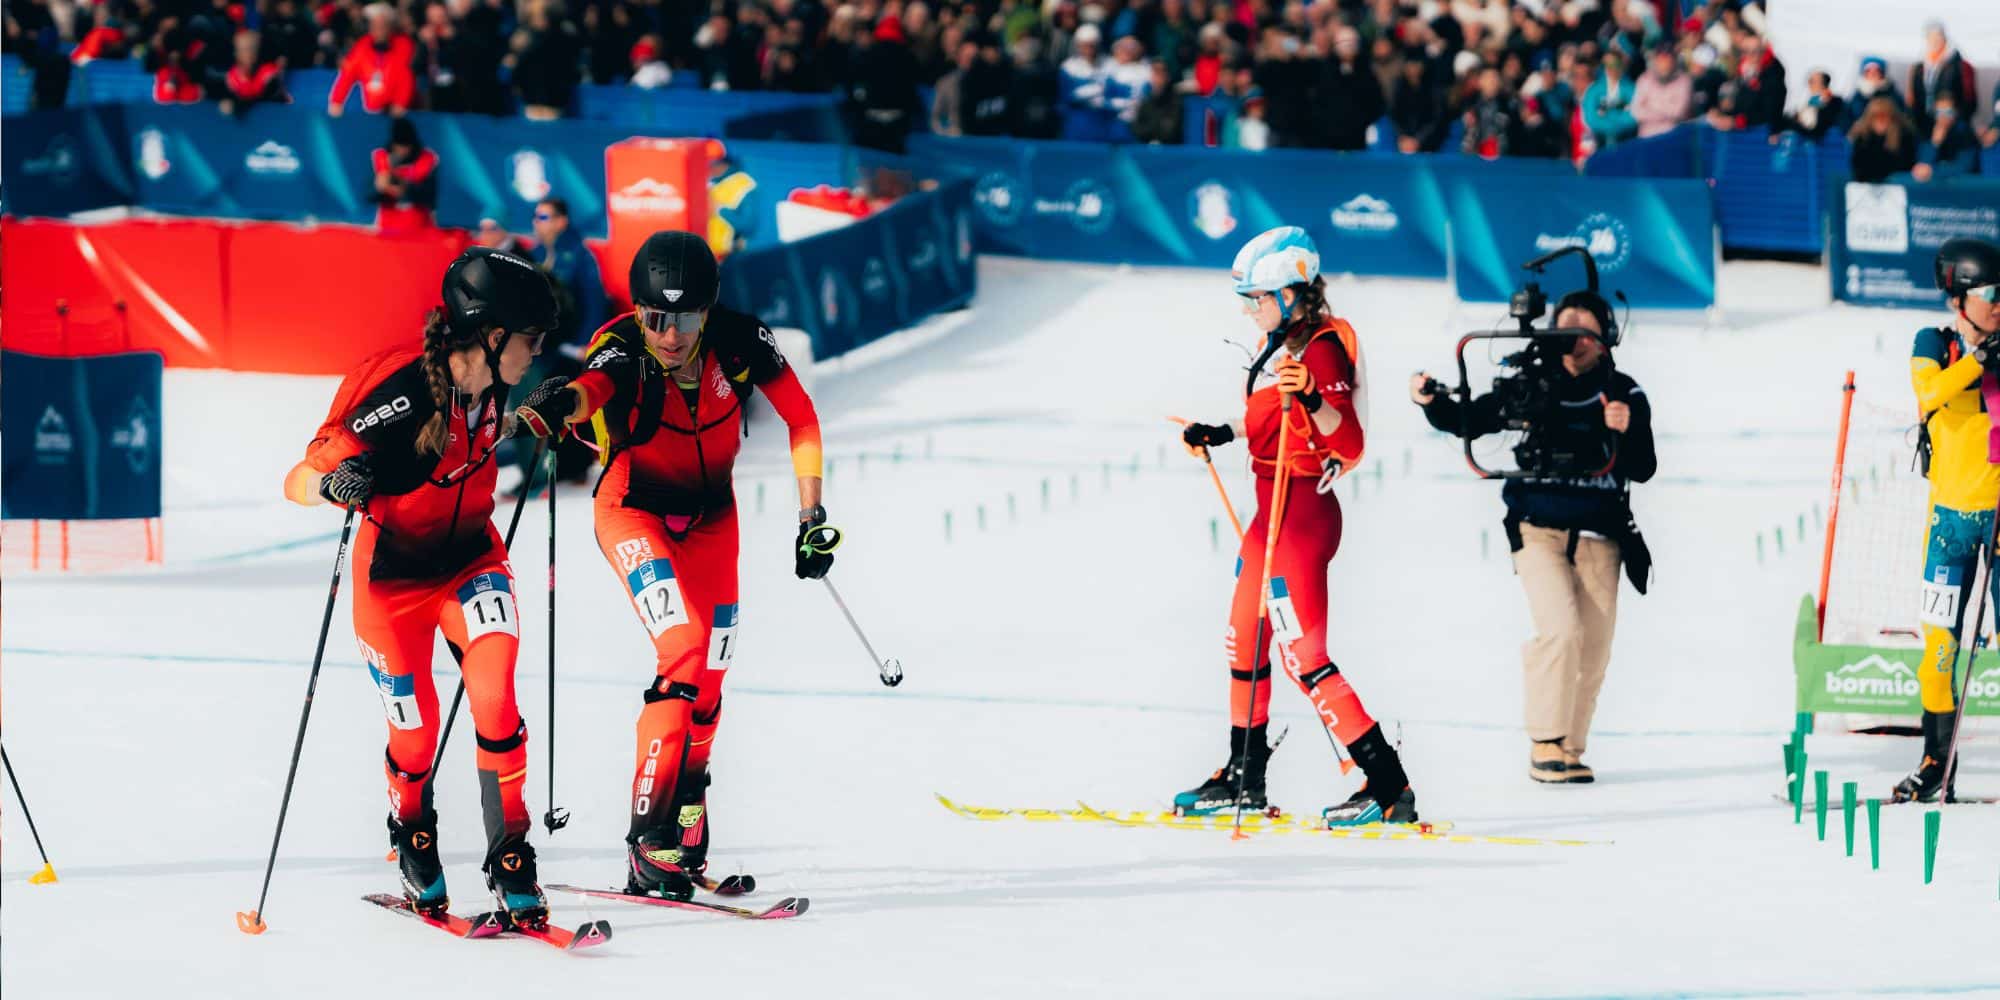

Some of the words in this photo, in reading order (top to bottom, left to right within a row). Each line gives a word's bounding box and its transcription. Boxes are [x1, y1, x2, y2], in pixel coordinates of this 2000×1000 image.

[473, 596, 507, 624] 1.1
[643, 587, 675, 624] 1.2
[1922, 588, 1954, 617] 17.1
[1825, 671, 1920, 696] bormio
